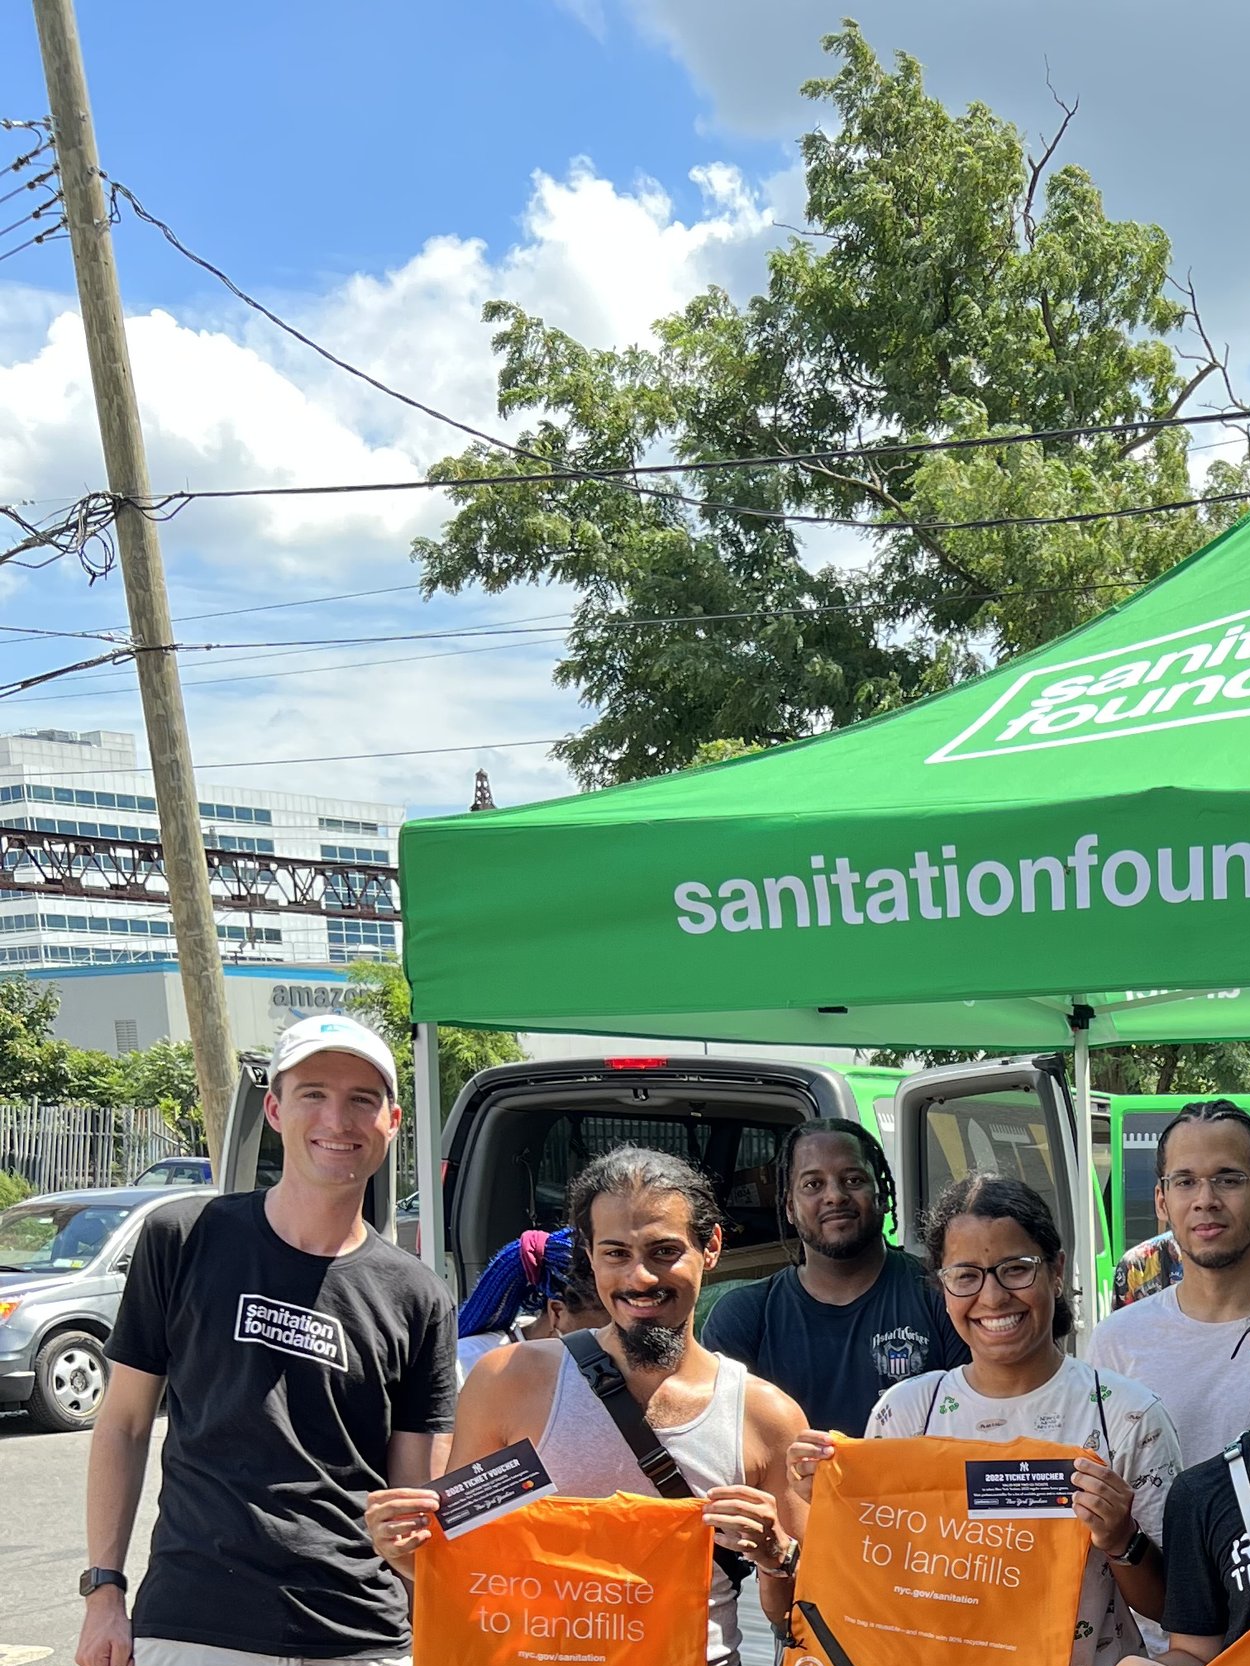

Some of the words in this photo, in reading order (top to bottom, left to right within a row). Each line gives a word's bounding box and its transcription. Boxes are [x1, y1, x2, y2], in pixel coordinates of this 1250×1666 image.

[244, 1317, 337, 1358] foundation
[246, 1304, 333, 1339] sanitation
[445, 1483, 464, 1497] 2022
[462, 1472, 488, 1489] TICKET
[487, 1458, 520, 1478] VOUCHER
[1005, 1473, 1030, 1481] TICKET
[1031, 1472, 1064, 1480] VOUCHER
[859, 1502, 926, 1533] zero
[939, 1516, 1034, 1551] waste
[862, 1535, 892, 1566] to
[904, 1543, 1020, 1587] landfills
[469, 1573, 541, 1599] zero
[554, 1579, 654, 1605] waste
[894, 1585, 979, 1605] nyc.gov/sanitation
[479, 1606, 510, 1633] to
[524, 1608, 644, 1641] landfills
[518, 1650, 606, 1662] nyc.gov/sanitation
